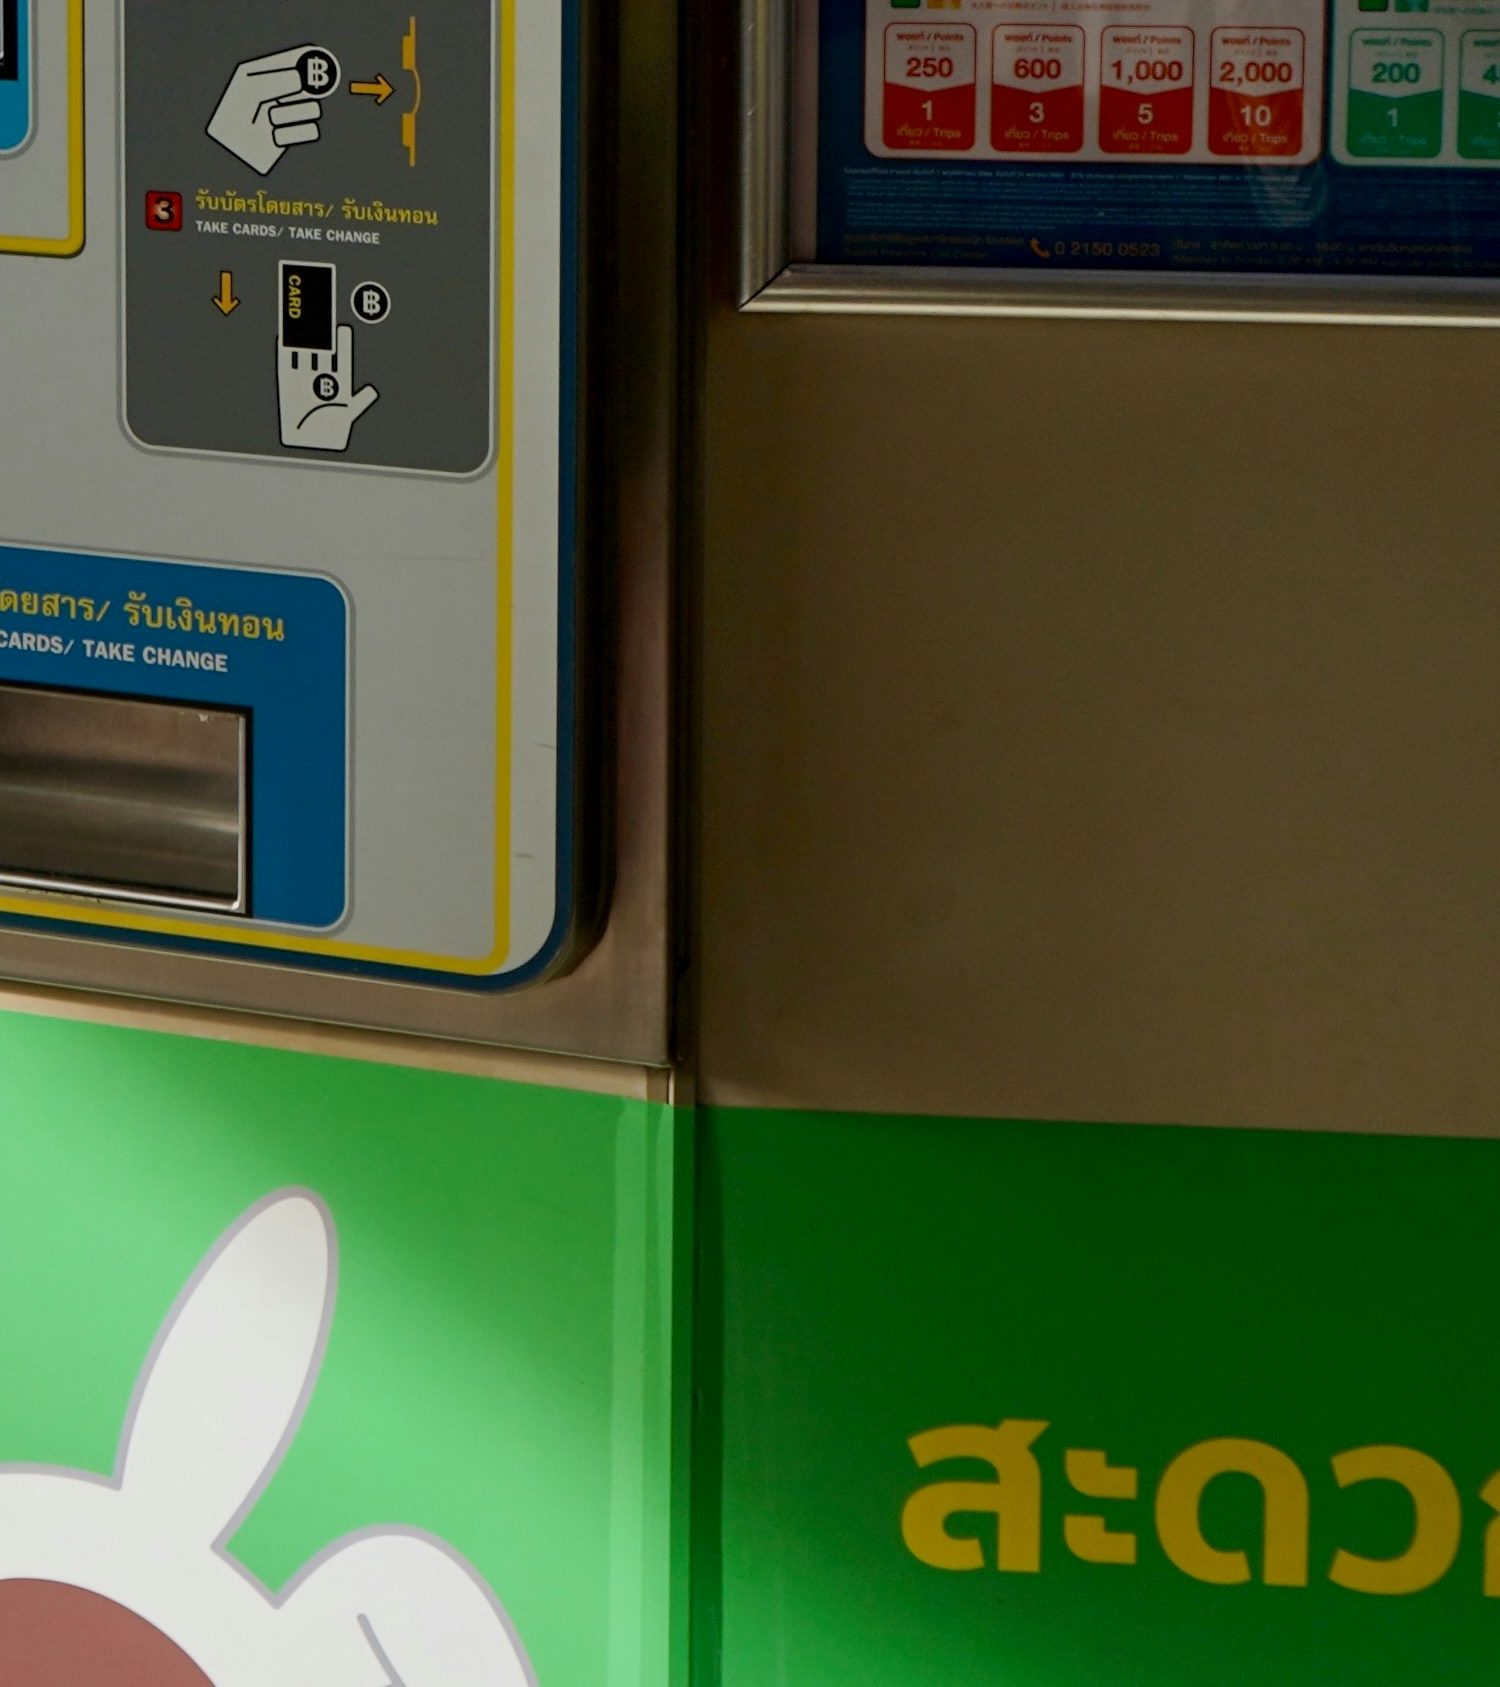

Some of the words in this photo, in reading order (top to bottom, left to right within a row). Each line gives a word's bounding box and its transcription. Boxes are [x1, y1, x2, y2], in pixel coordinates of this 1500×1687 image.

[906, 58, 953, 79] 250
[1014, 59, 1061, 80] 600
[1111, 60, 1183, 85] 1,000
[1219, 61, 1292, 86] 2,000
[1371, 63, 1421, 85] 200
[342, 201, 438, 226] รับเงินทอน
[195, 220, 229, 235] TAKE
[233, 222, 284, 238] CARDS/
[289, 225, 323, 240] TAKE
[327, 227, 380, 245] CHANGE
[287, 273, 302, 320] CARD
[124, 597, 286, 643] รับเงินทอน
[83, 640, 135, 663] TAKE
[142, 645, 228, 673] CHANGE
